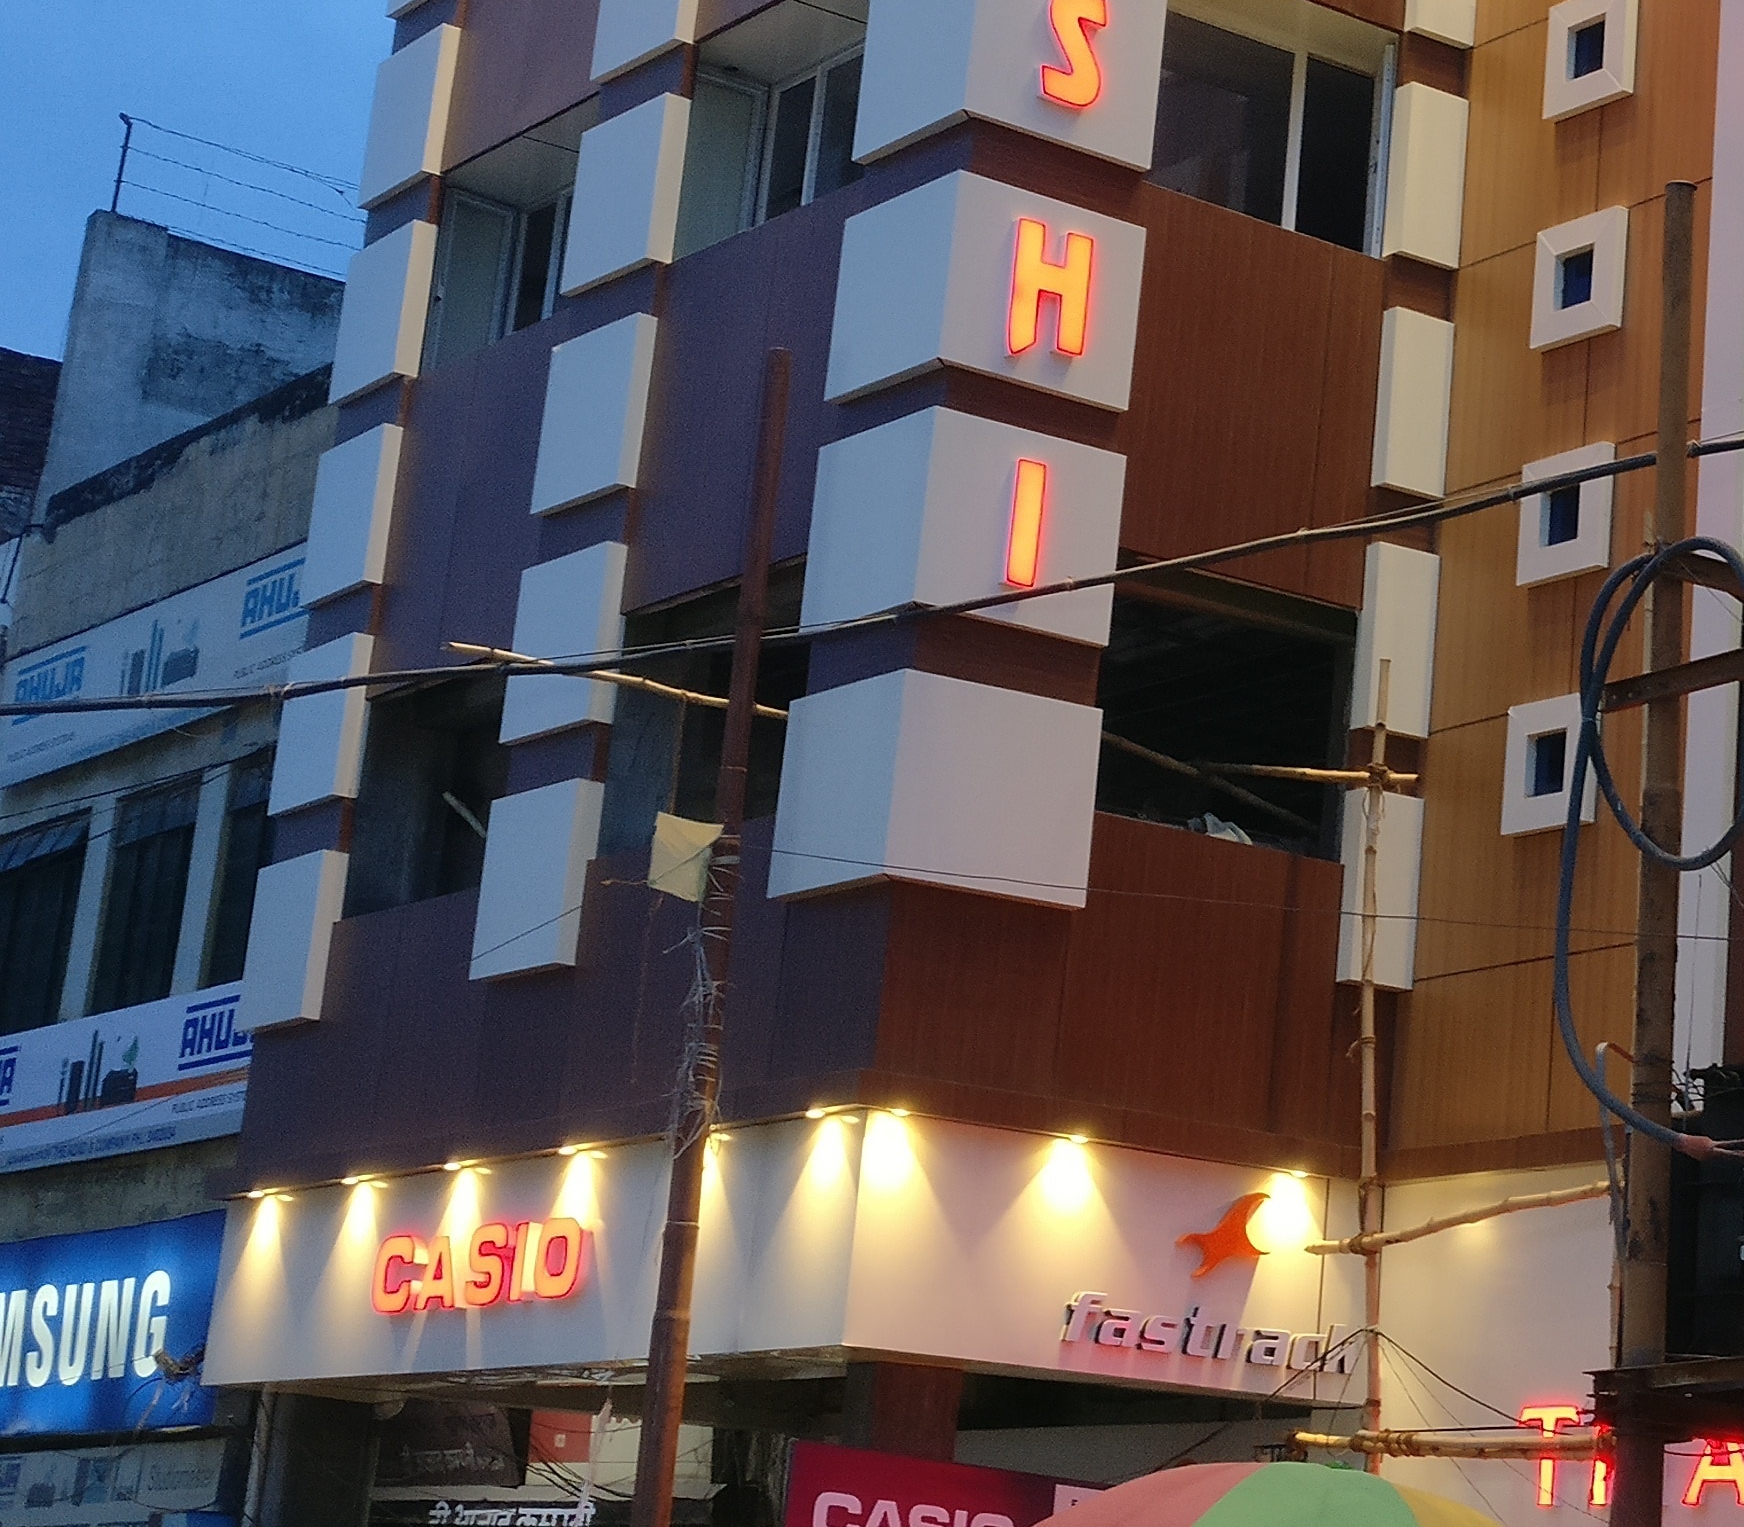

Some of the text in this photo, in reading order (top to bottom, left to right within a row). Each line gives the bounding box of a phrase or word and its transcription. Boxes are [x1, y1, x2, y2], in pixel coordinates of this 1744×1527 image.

[14, 656, 85, 704] AHUJA
[178, 1008, 254, 1059] AHU
[0, 1057, 17, 1094] A
[372, 1216, 584, 1315] CASIO
[1060, 1290, 1364, 1374] fastrack
